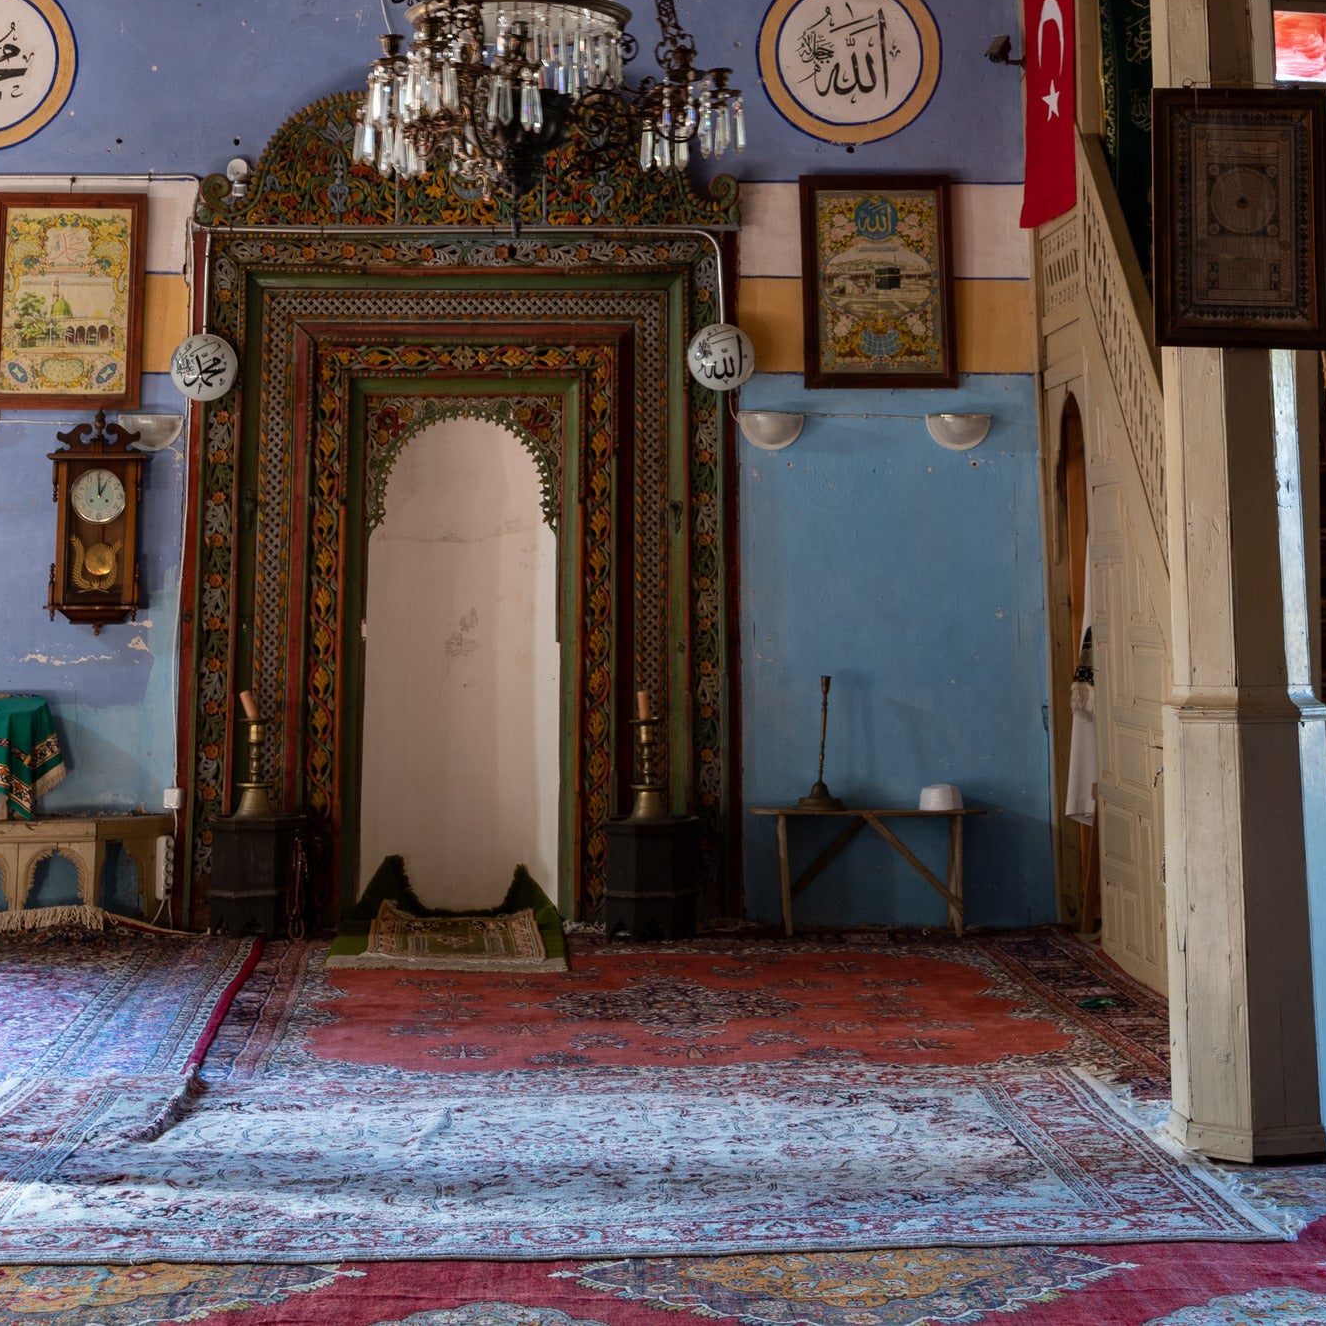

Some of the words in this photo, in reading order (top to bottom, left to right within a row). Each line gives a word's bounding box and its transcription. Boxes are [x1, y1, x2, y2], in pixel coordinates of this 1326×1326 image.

[814, 8, 889, 100] الله
[858, 204, 893, 234] الله
[184, 355, 226, 387] محمد
[704, 334, 743, 380] الله
